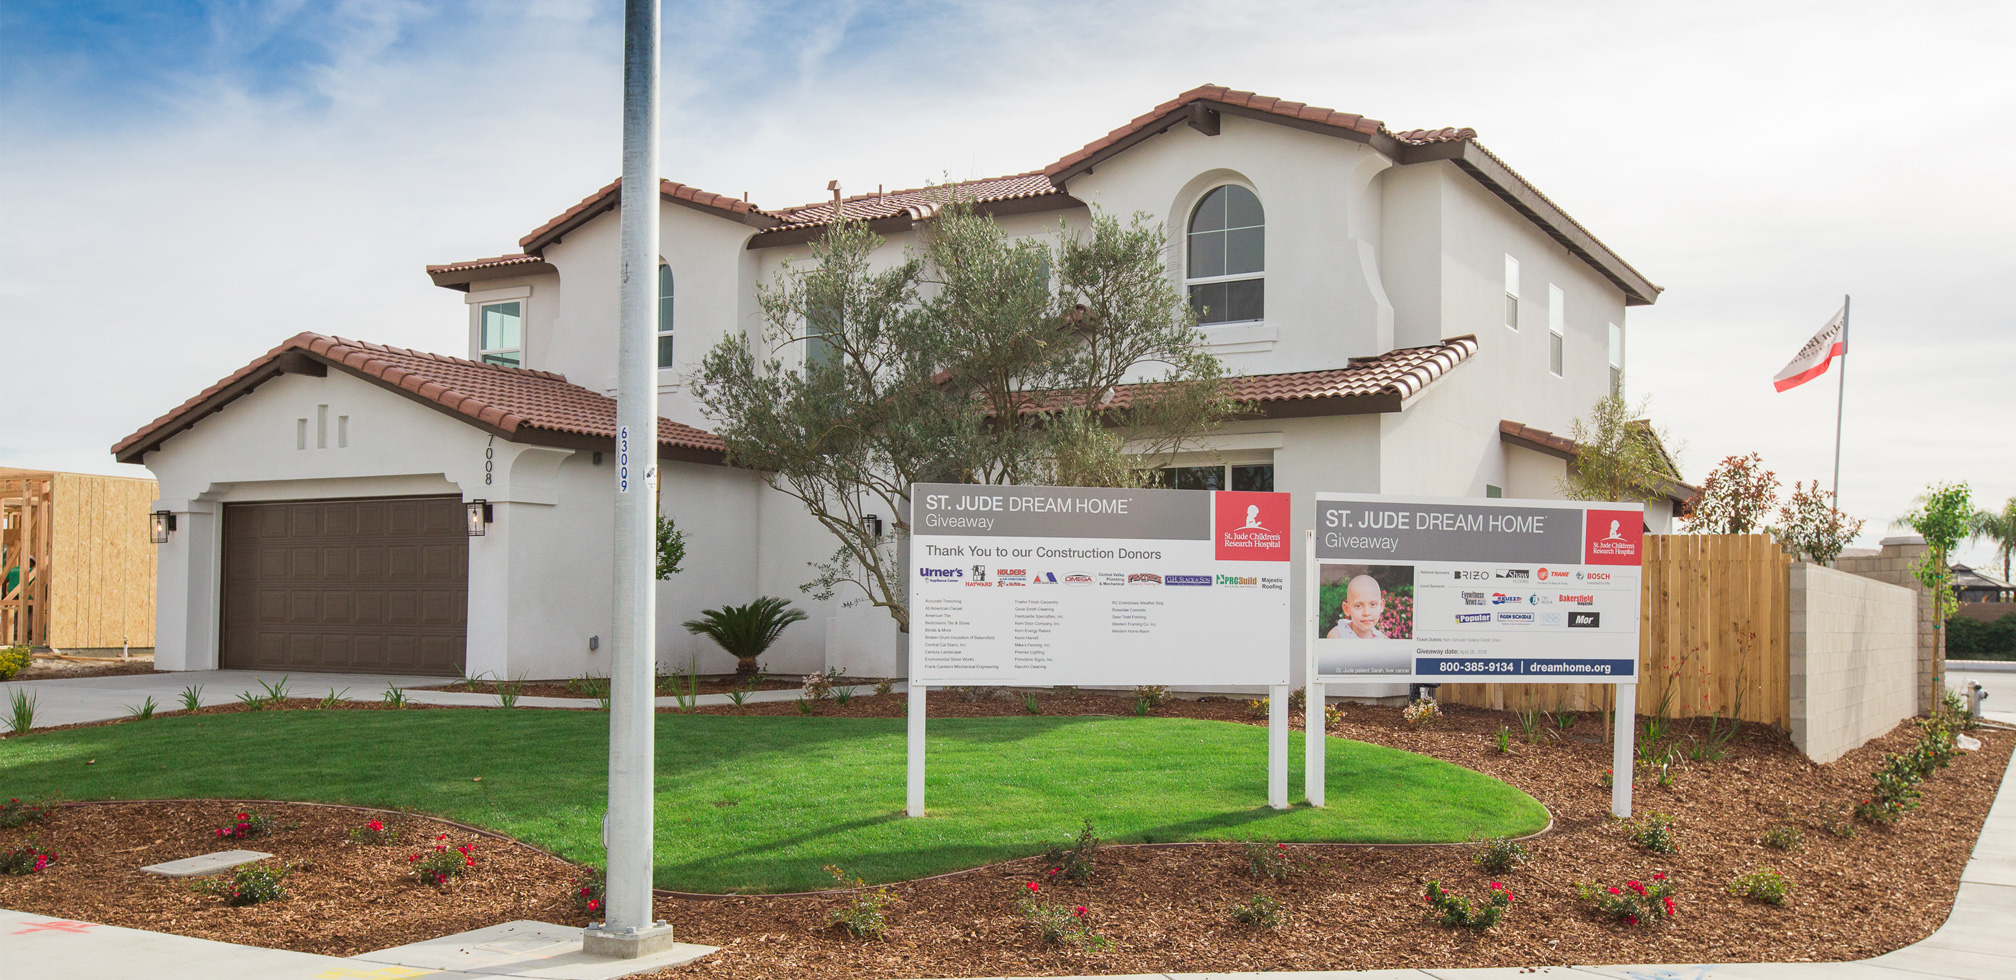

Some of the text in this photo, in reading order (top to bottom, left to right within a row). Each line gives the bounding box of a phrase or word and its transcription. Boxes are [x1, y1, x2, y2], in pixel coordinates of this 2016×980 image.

[485, 434, 494, 485] 7008
[926, 494, 1128, 514] ST. JUDE DREAM HOME
[925, 514, 994, 530] Giveaway
[1325, 510, 1544, 533] ST. JUDE DREAM HOME
[1254, 541, 1280, 549] Hospital
[1325, 532, 1398, 552] Giveaway
[926, 545, 1162, 560] Thank You to our Construction Donors
[920, 568, 963, 577] Urner's
[1454, 571, 1489, 580] BRIZO
[1462, 591, 1484, 599] Eyewitness
[1460, 614, 1490, 622] Popular
[1576, 615, 1594, 624] Mor
[1440, 662, 1514, 672] 800-385-9134
[1530, 662, 1611, 674] dreamhome.org
